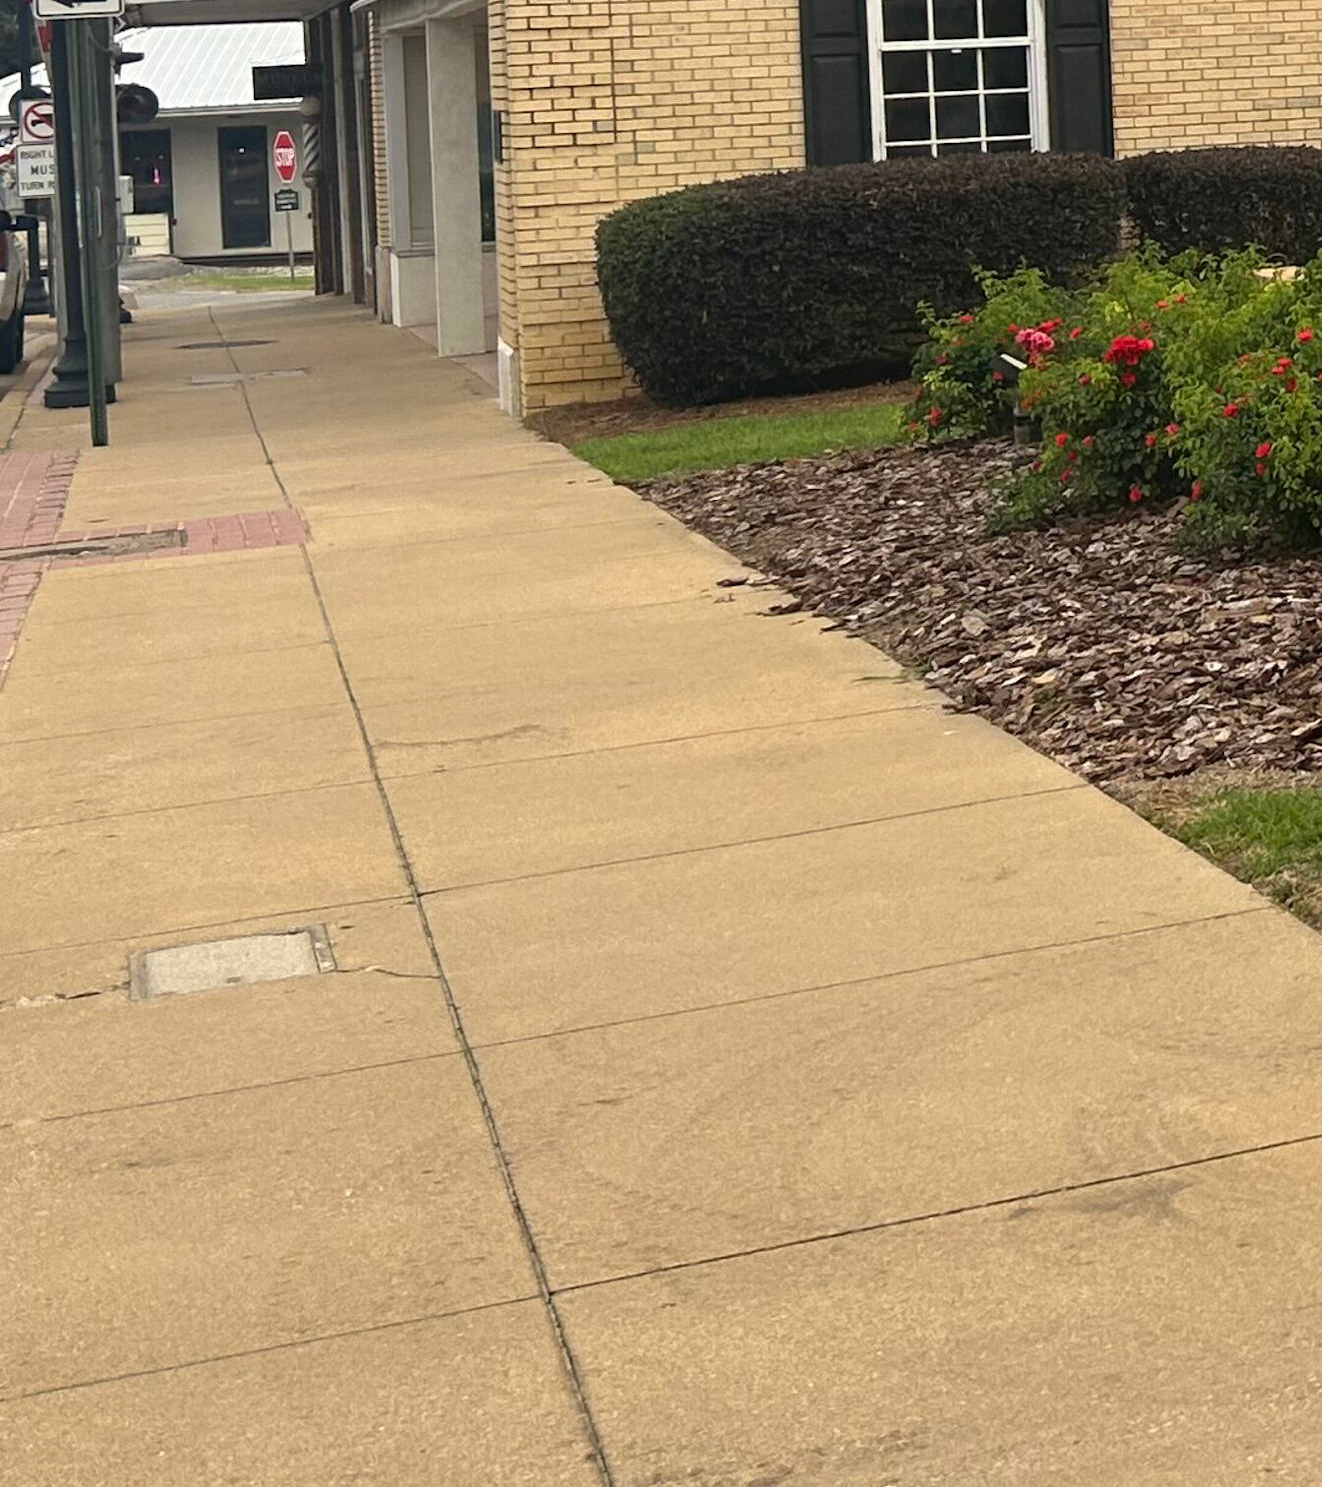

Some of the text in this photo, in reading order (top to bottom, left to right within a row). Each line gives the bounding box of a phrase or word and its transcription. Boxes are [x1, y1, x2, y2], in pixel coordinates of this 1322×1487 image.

[20, 150, 46, 159] RIGHT
[276, 148, 295, 166] STOP
[31, 165, 55, 175] MUS
